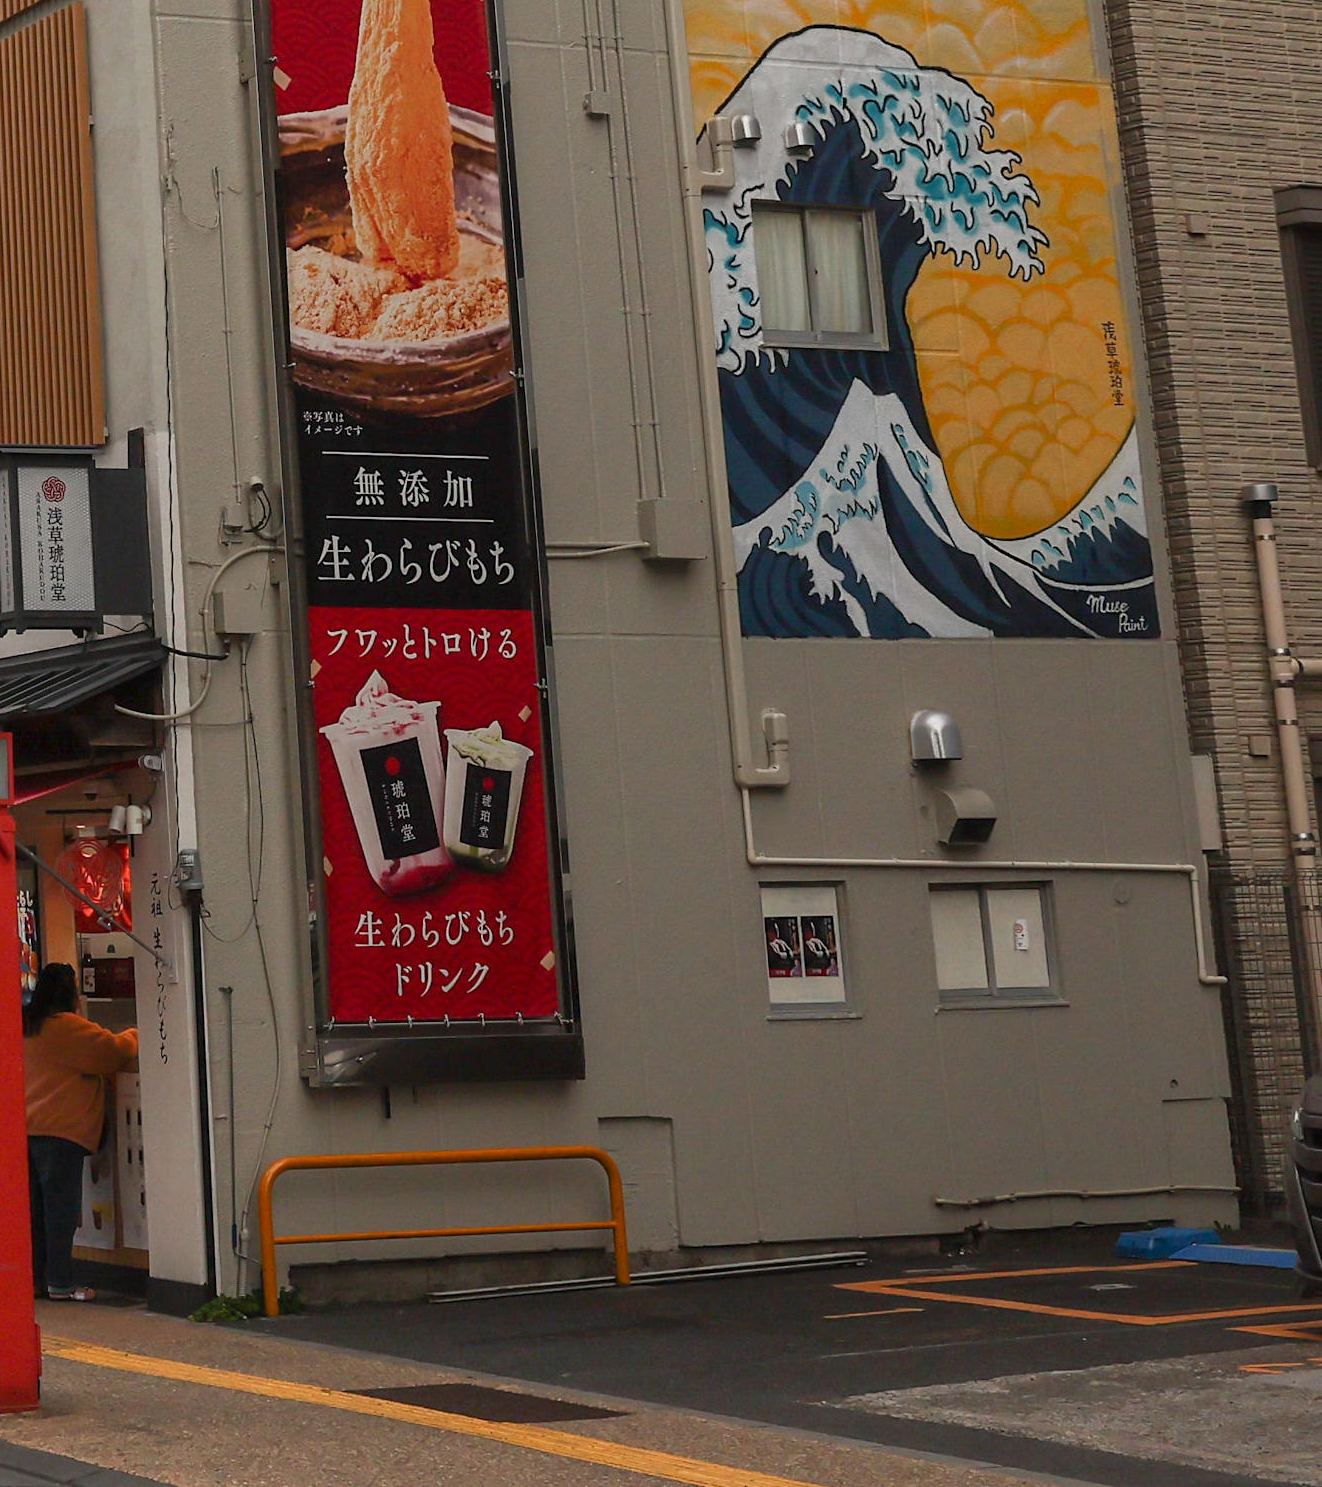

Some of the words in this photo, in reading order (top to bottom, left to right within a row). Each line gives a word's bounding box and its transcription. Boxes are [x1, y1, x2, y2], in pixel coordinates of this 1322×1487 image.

[304, 424, 364, 436] イメージです
[353, 465, 475, 510] 無添加
[47, 507, 67, 602] 浅草琥珀堂
[317, 534, 516, 587] 生わらびもち
[1086, 593, 1130, 614] Muse
[1118, 612, 1149, 634] Paint
[326, 623, 518, 662] フワッとトロける
[390, 779, 416, 843] 琥珀堂
[354, 910, 516, 948] 生わらびもち
[394, 961, 491, 998] ドリンク
